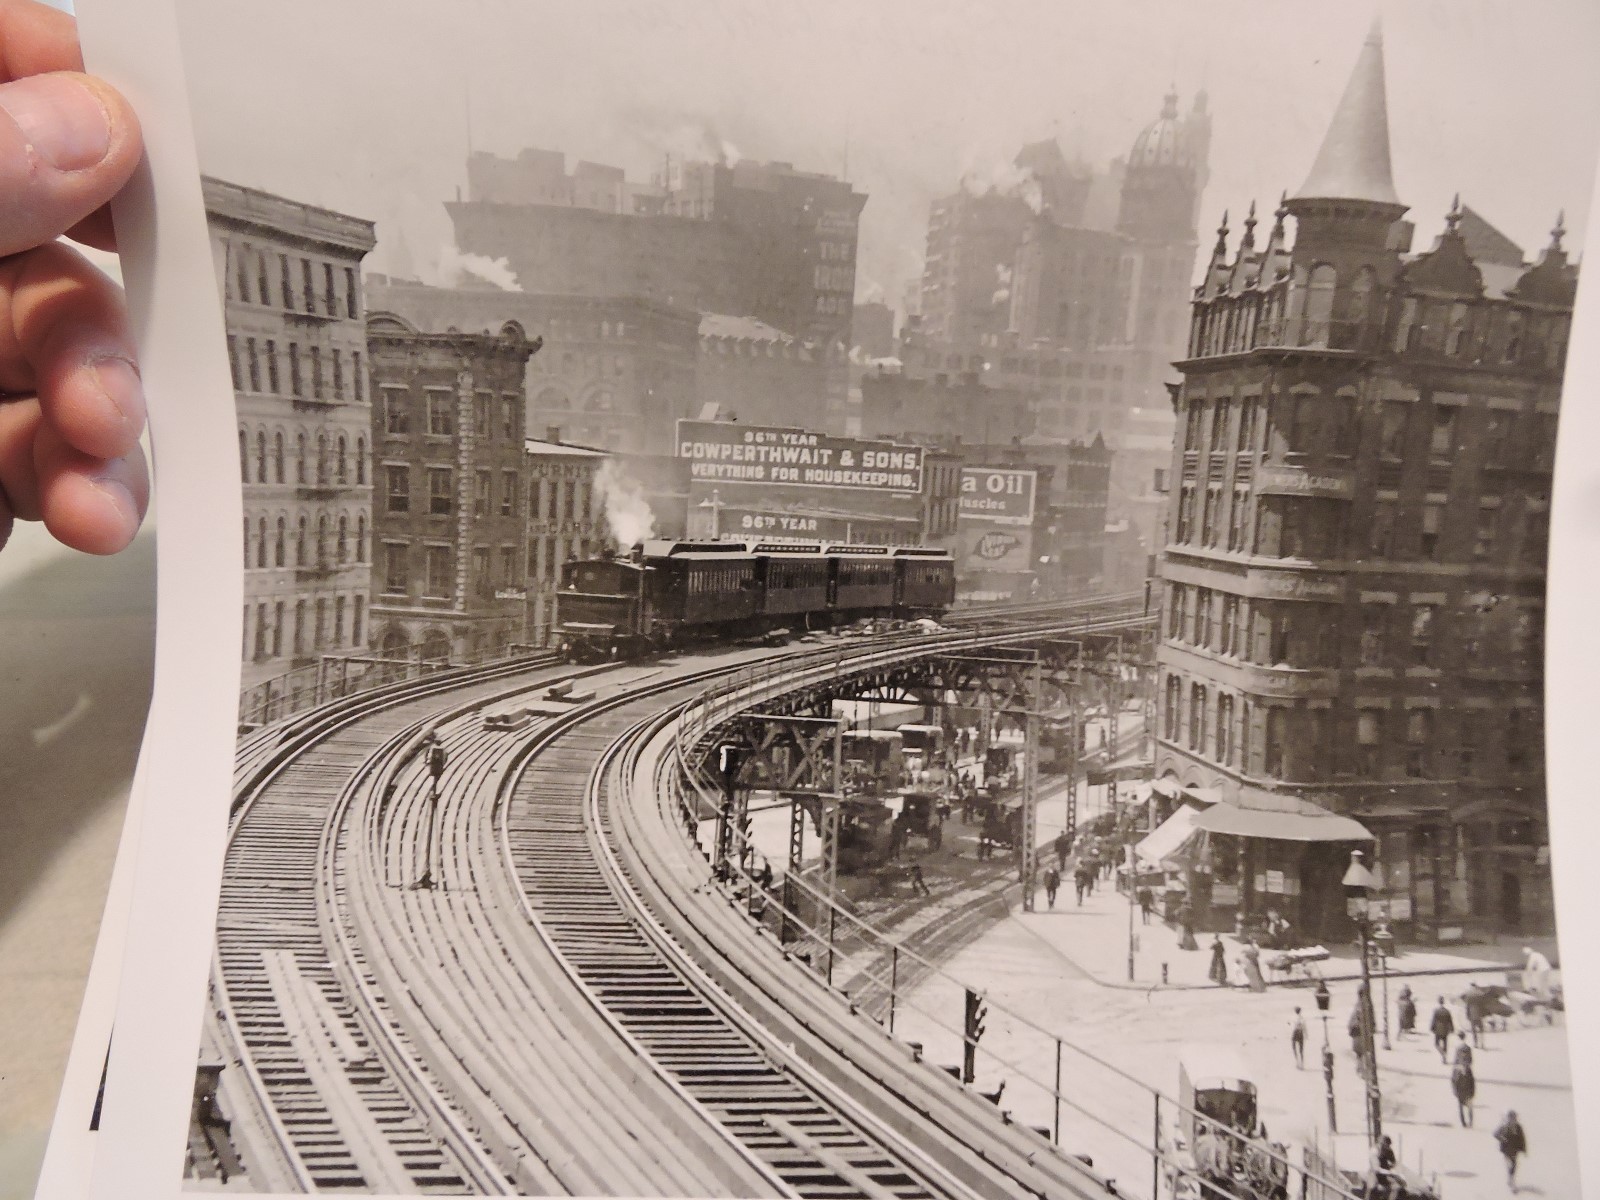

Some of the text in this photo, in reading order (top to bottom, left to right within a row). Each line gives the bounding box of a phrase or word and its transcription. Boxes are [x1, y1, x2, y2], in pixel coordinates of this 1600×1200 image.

[781, 433, 818, 446] YEAR
[680, 441, 833, 465] COWPERTHWAIT
[839, 449, 855, 467] &
[771, 466, 799, 481] FOR
[986, 474, 1024, 495] Oil
[779, 517, 817, 531] YEAR
